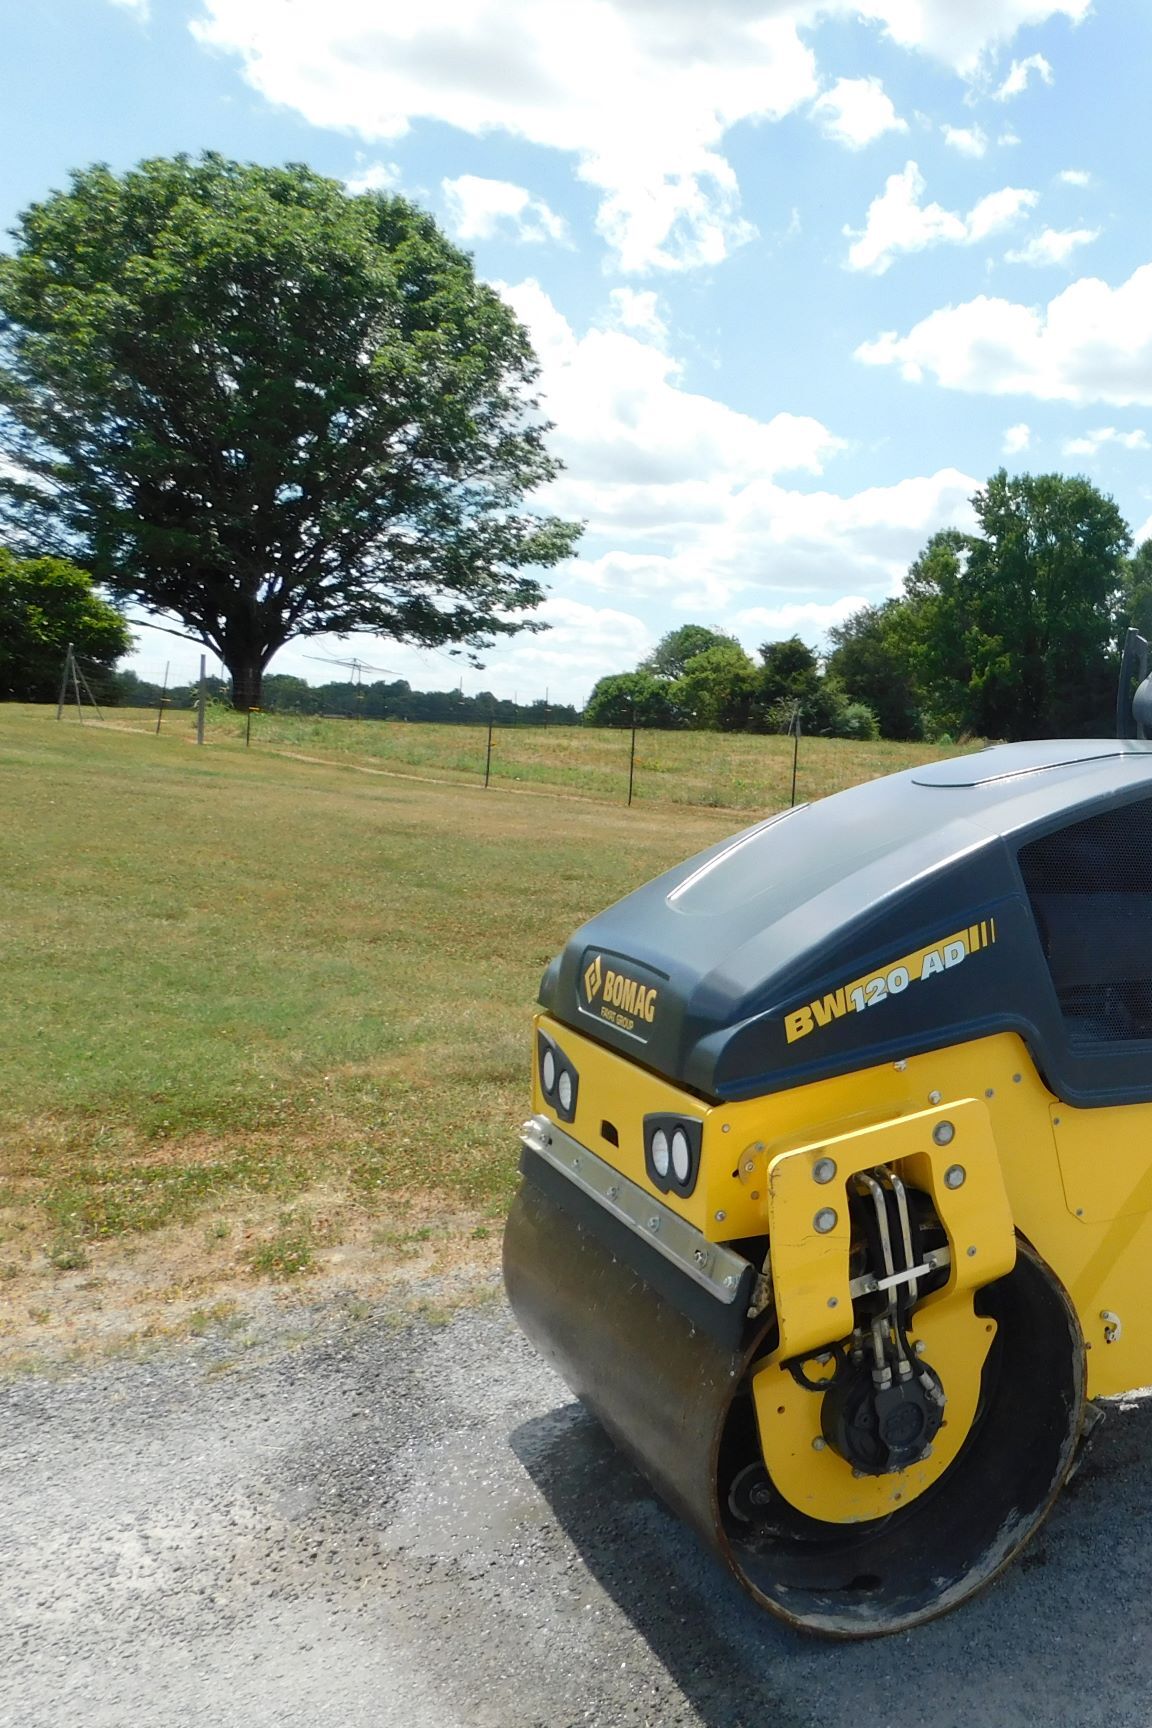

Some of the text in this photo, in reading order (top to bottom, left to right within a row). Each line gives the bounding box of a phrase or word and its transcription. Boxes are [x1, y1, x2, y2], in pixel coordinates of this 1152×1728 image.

[602, 970, 657, 1023] BOMAG
[784, 940, 965, 1044] BW 120 AD
